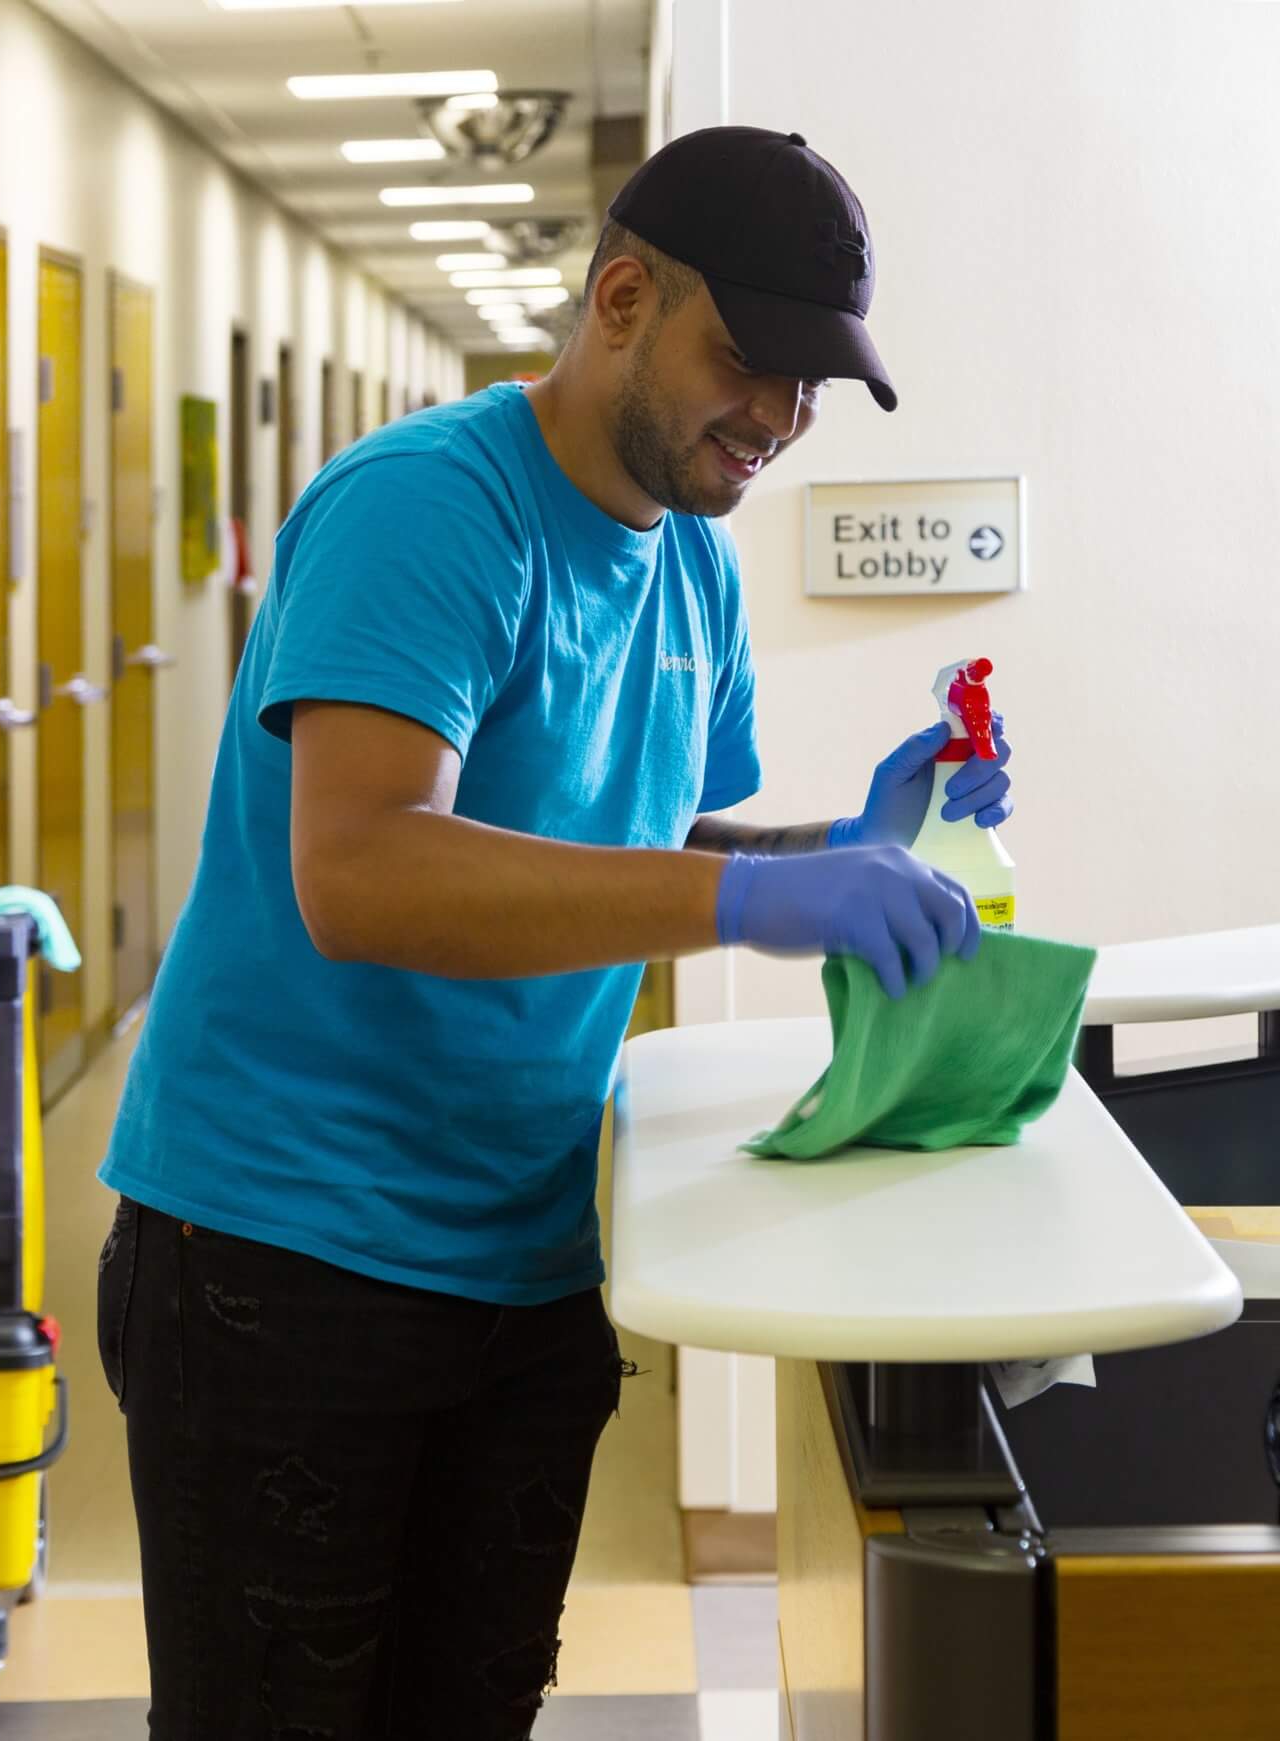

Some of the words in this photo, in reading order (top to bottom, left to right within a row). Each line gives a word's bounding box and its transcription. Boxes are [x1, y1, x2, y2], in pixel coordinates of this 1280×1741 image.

[833, 514, 901, 543] Exit
[917, 515, 951, 541] to
[836, 549, 949, 584] Lobby
[659, 650, 699, 672] Servic
